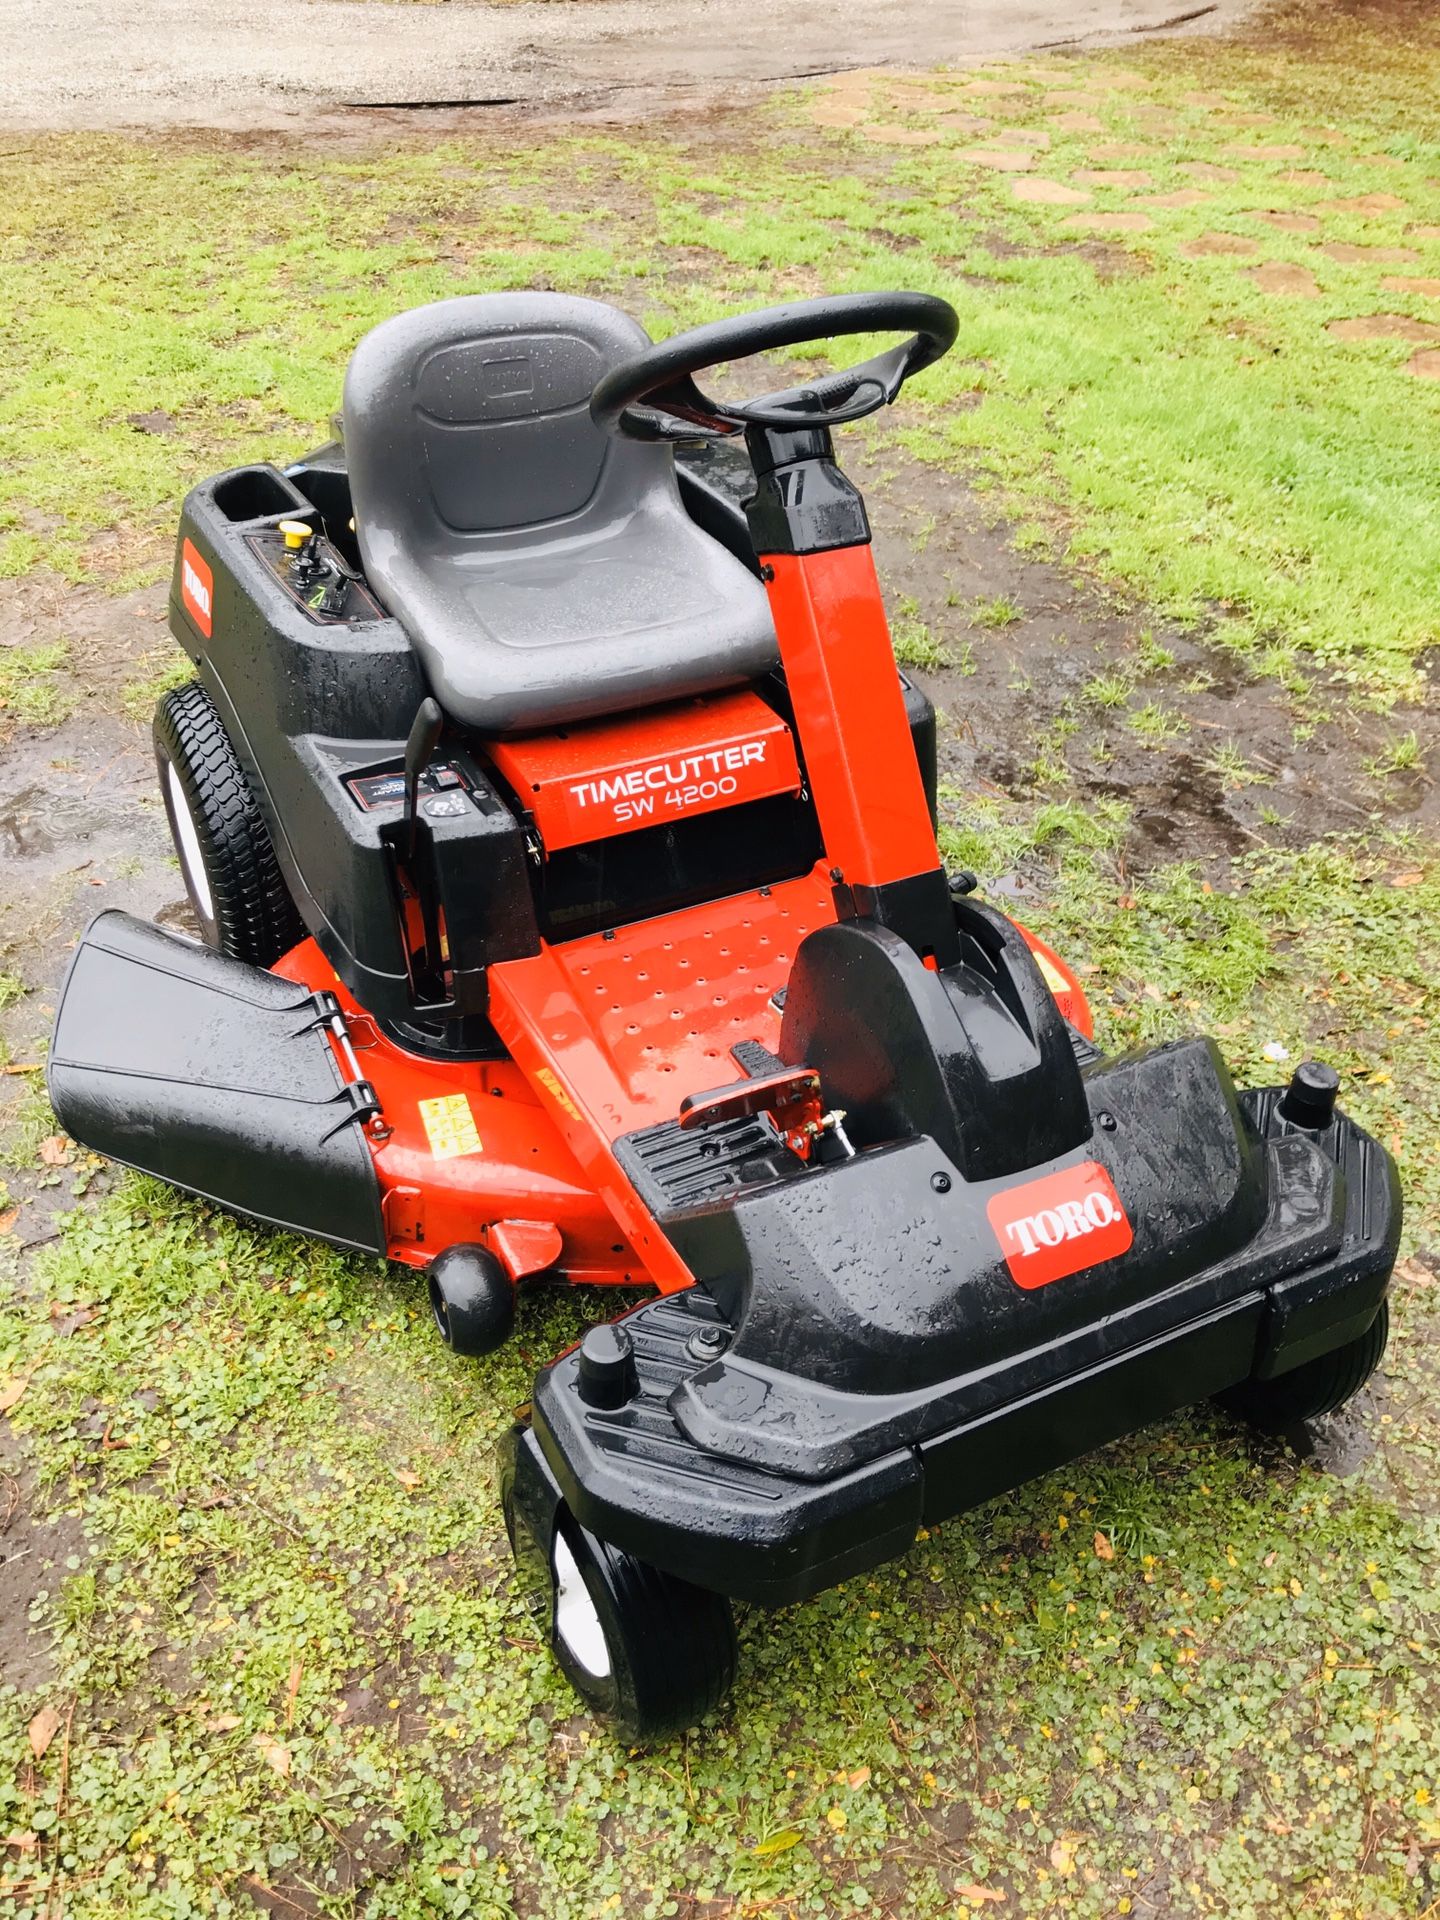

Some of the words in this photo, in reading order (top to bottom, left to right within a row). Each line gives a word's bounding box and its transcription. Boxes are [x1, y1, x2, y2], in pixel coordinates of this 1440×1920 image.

[570, 741, 766, 807] TIMECUTTER
[613, 796, 654, 822] SW
[664, 776, 737, 807] 4200
